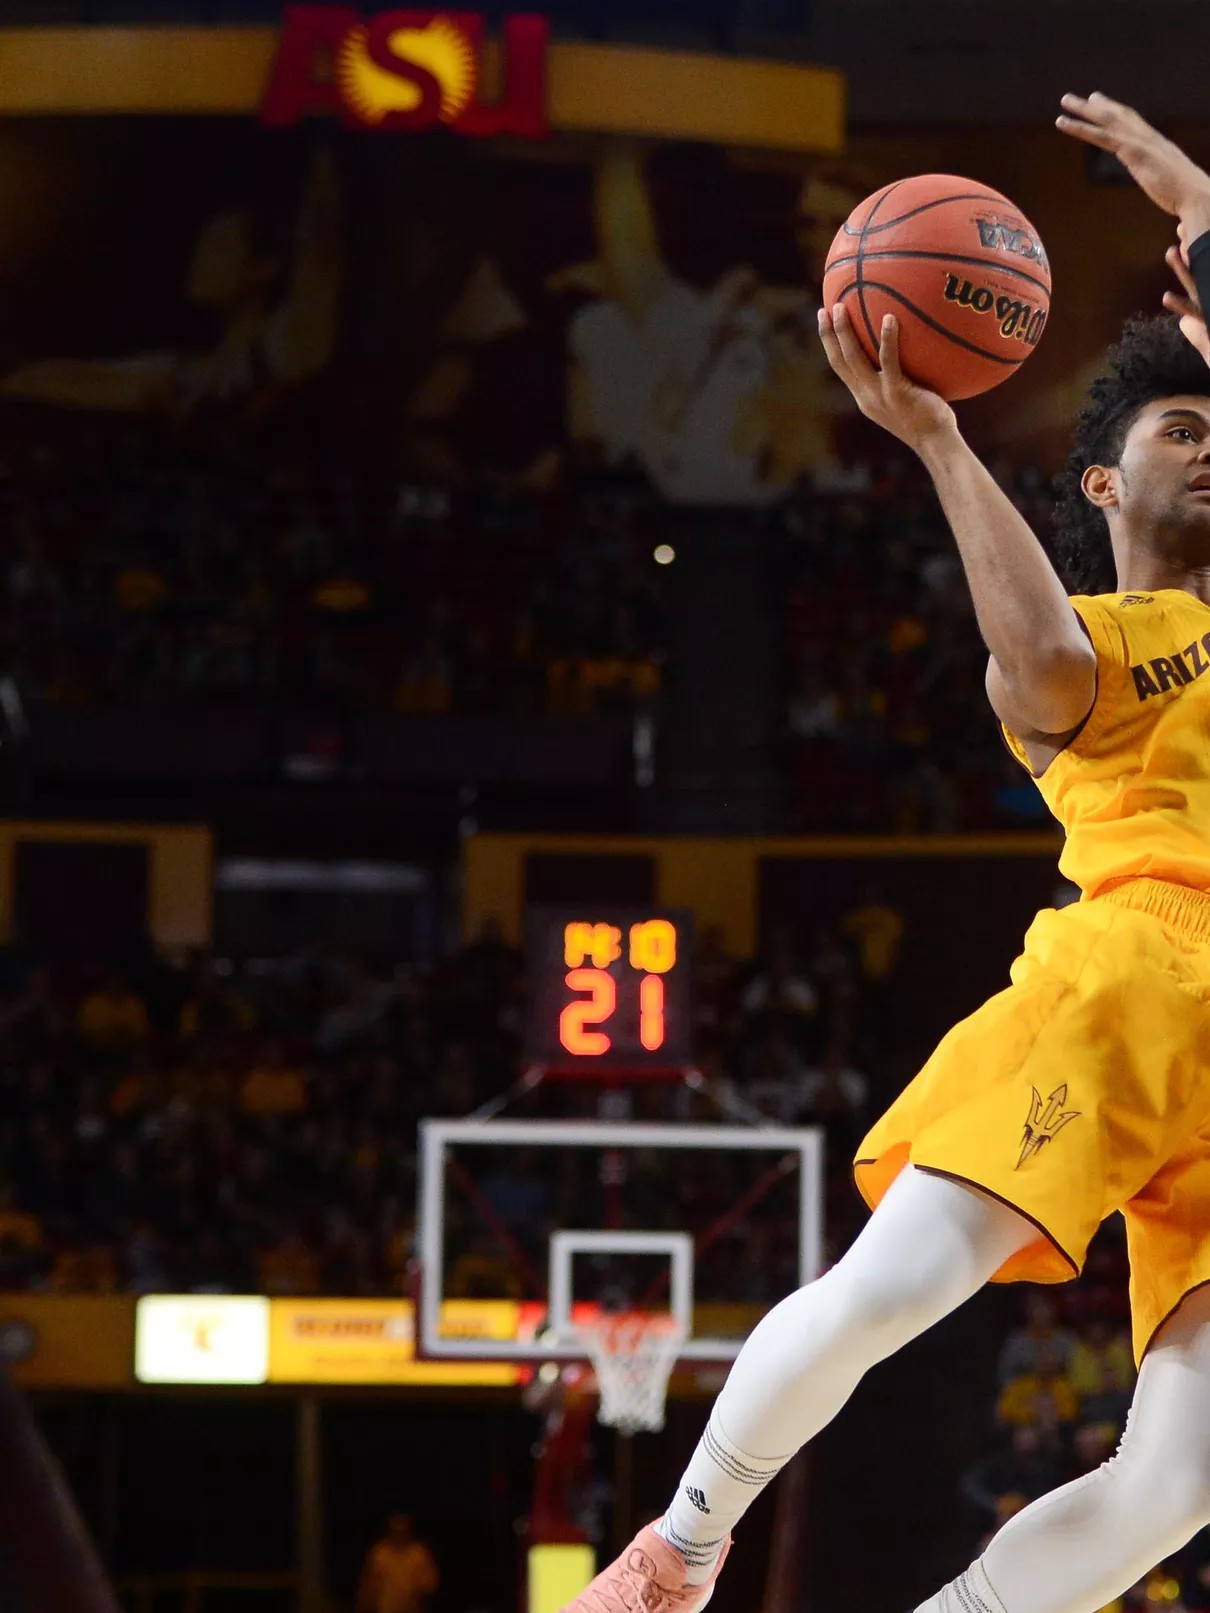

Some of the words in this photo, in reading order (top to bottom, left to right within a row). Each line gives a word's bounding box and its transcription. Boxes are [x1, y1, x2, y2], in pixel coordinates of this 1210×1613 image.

[260, 4, 548, 137] ASU
[943, 272, 1048, 346] Wilson
[559, 968, 664, 1056] 21
